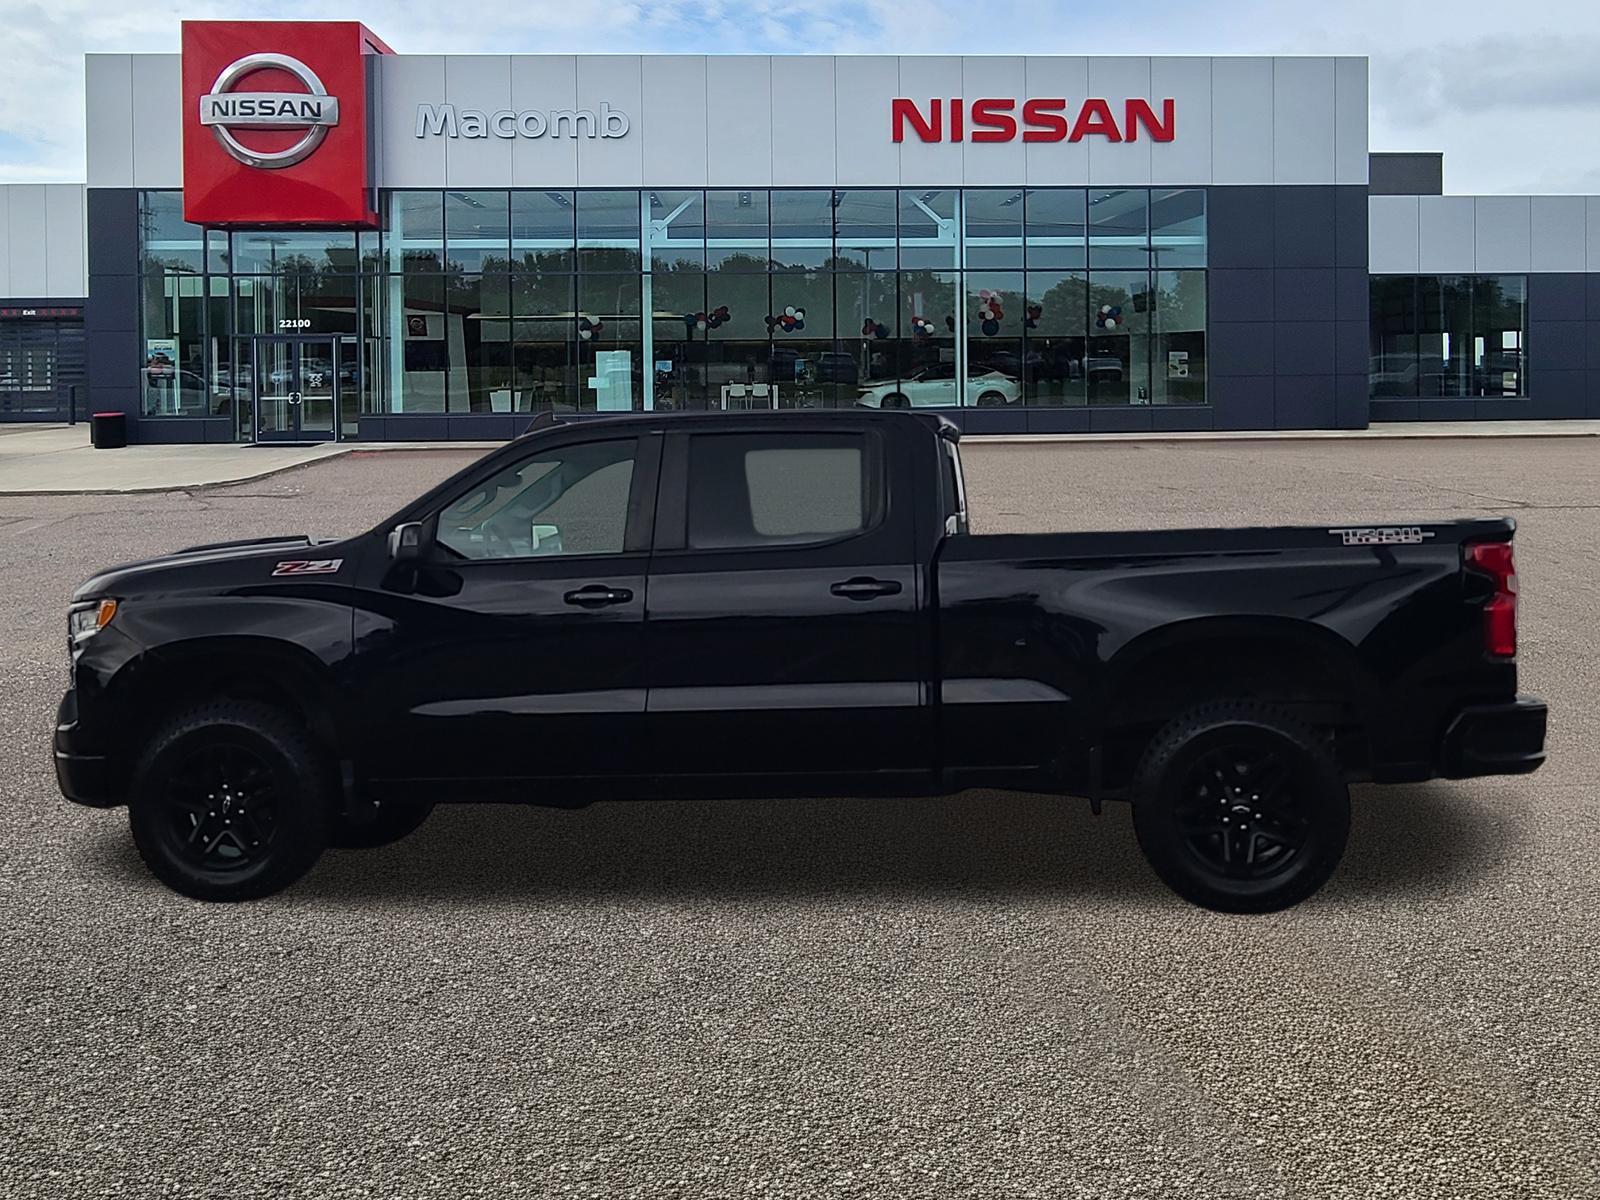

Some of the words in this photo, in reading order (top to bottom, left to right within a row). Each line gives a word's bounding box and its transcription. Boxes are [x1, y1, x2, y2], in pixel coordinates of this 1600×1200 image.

[211, 100, 322, 118] NISSAN
[415, 101, 630, 139] Macomb
[891, 98, 1176, 143] NISSAN
[279, 319, 311, 328] 22100
[271, 558, 344, 576] Z71
